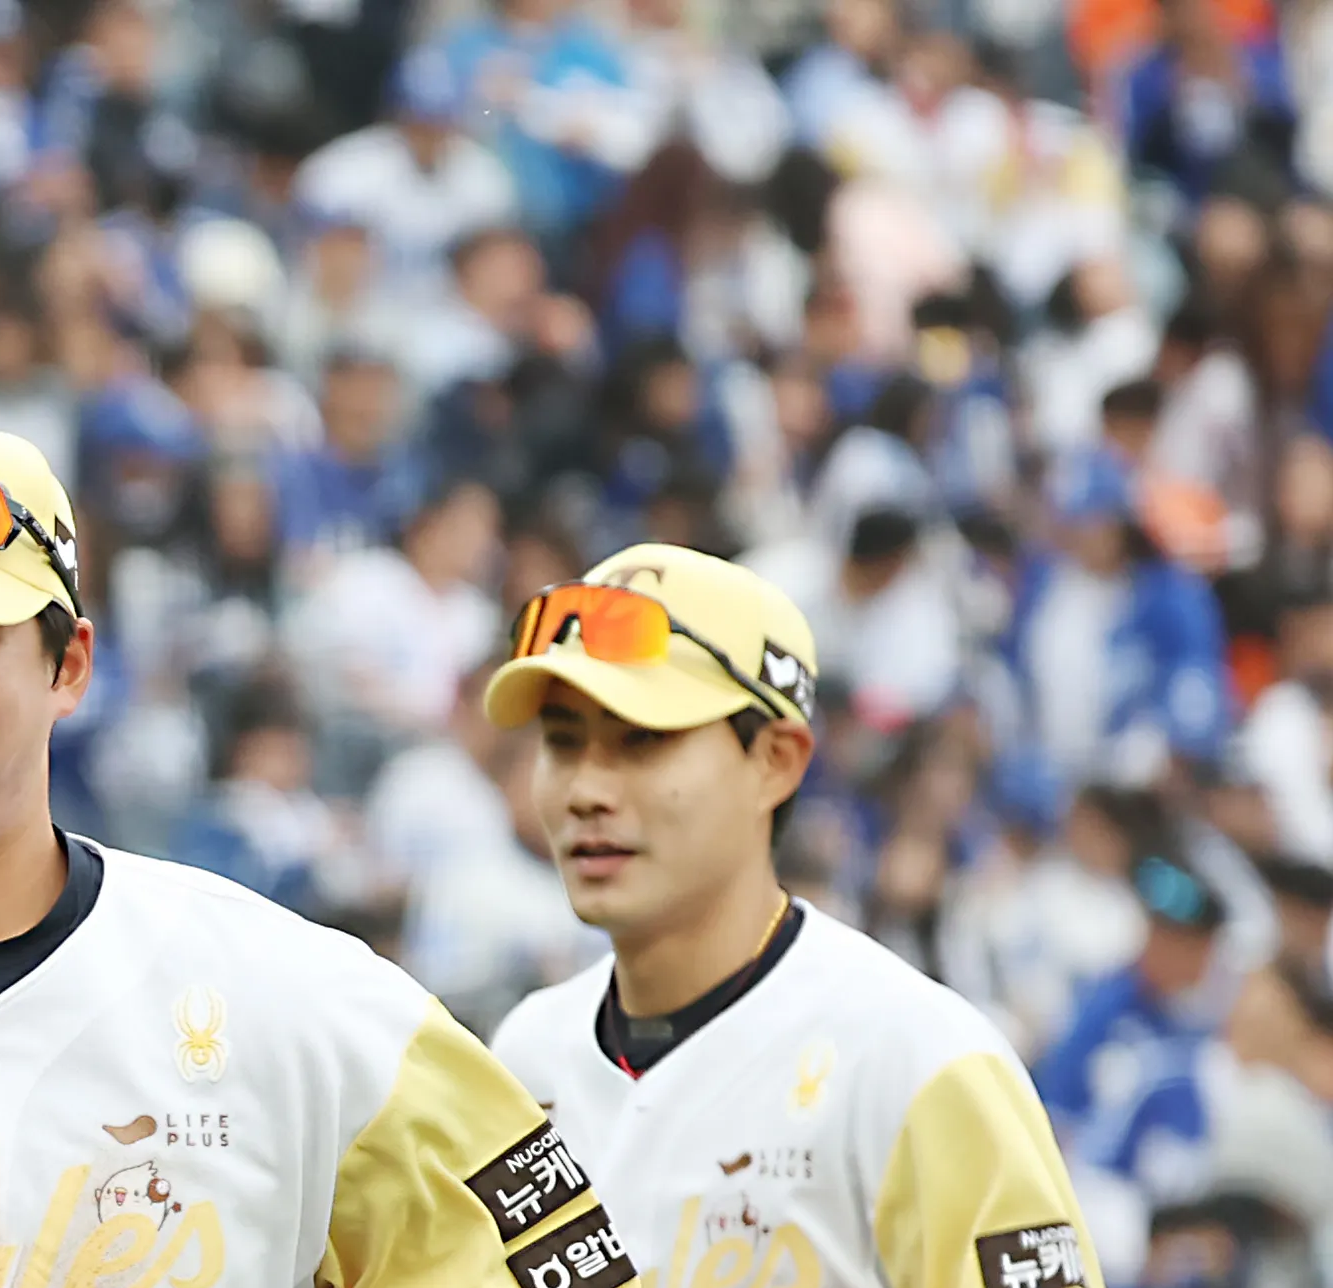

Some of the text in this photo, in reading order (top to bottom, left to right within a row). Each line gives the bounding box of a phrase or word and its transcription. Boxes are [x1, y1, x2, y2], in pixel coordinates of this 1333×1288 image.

[165, 1113, 230, 1129] LIFE
[166, 1131, 230, 1148] PLUS
[495, 1145, 584, 1226] 뉴케
